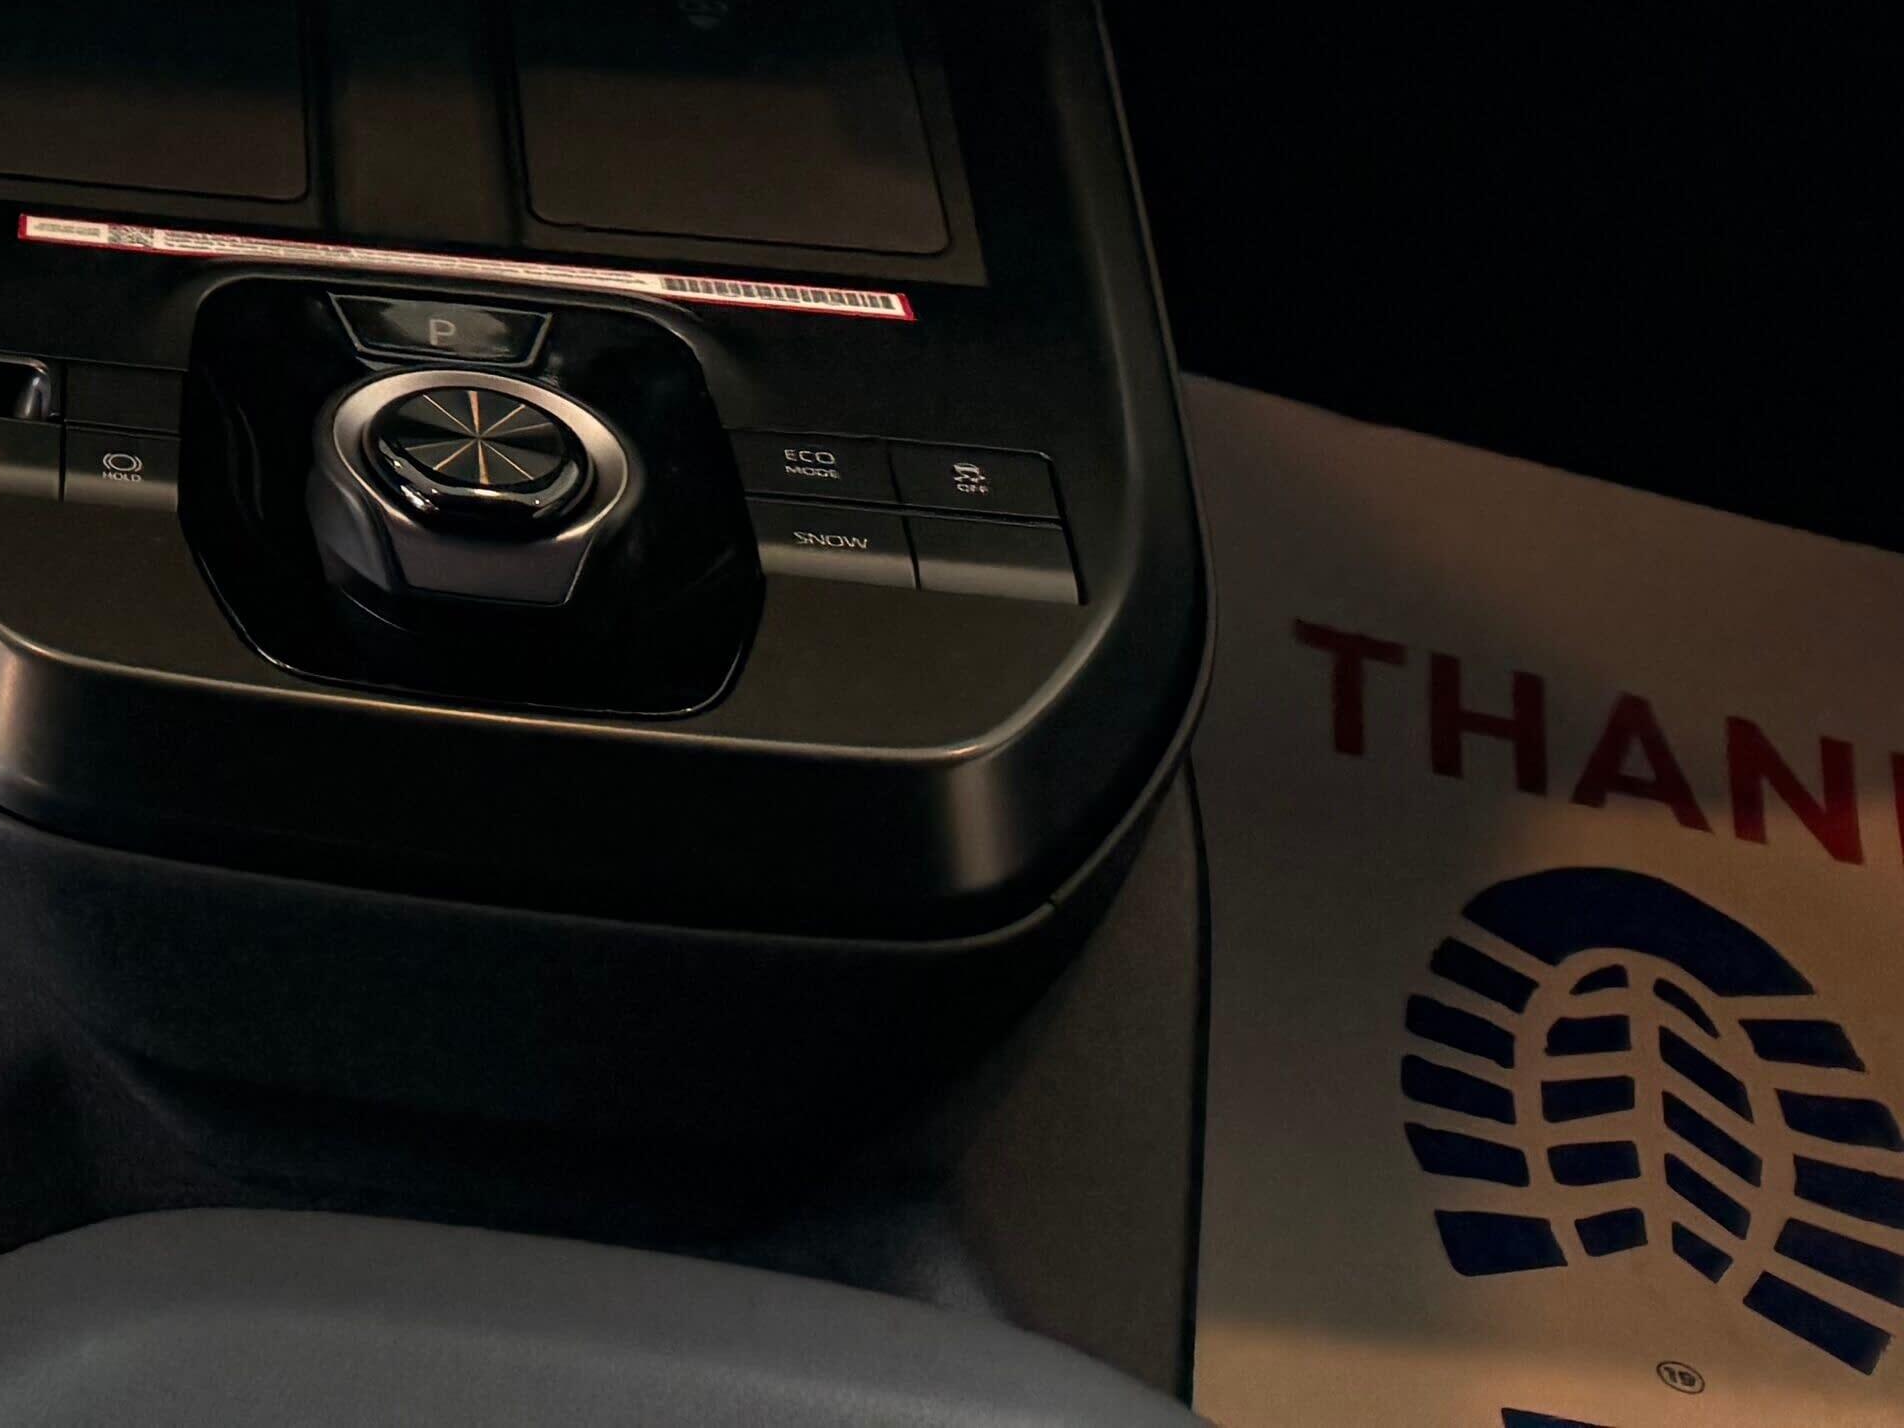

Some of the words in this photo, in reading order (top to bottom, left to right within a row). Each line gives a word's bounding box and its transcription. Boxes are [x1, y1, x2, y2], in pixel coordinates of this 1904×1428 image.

[429, 318, 457, 346] P
[783, 448, 836, 465] ECO
[101, 470, 142, 483] HOLD
[784, 465, 841, 480] MODE
[793, 530, 869, 550] SNOW
[1295, 618, 1904, 866] THAN
